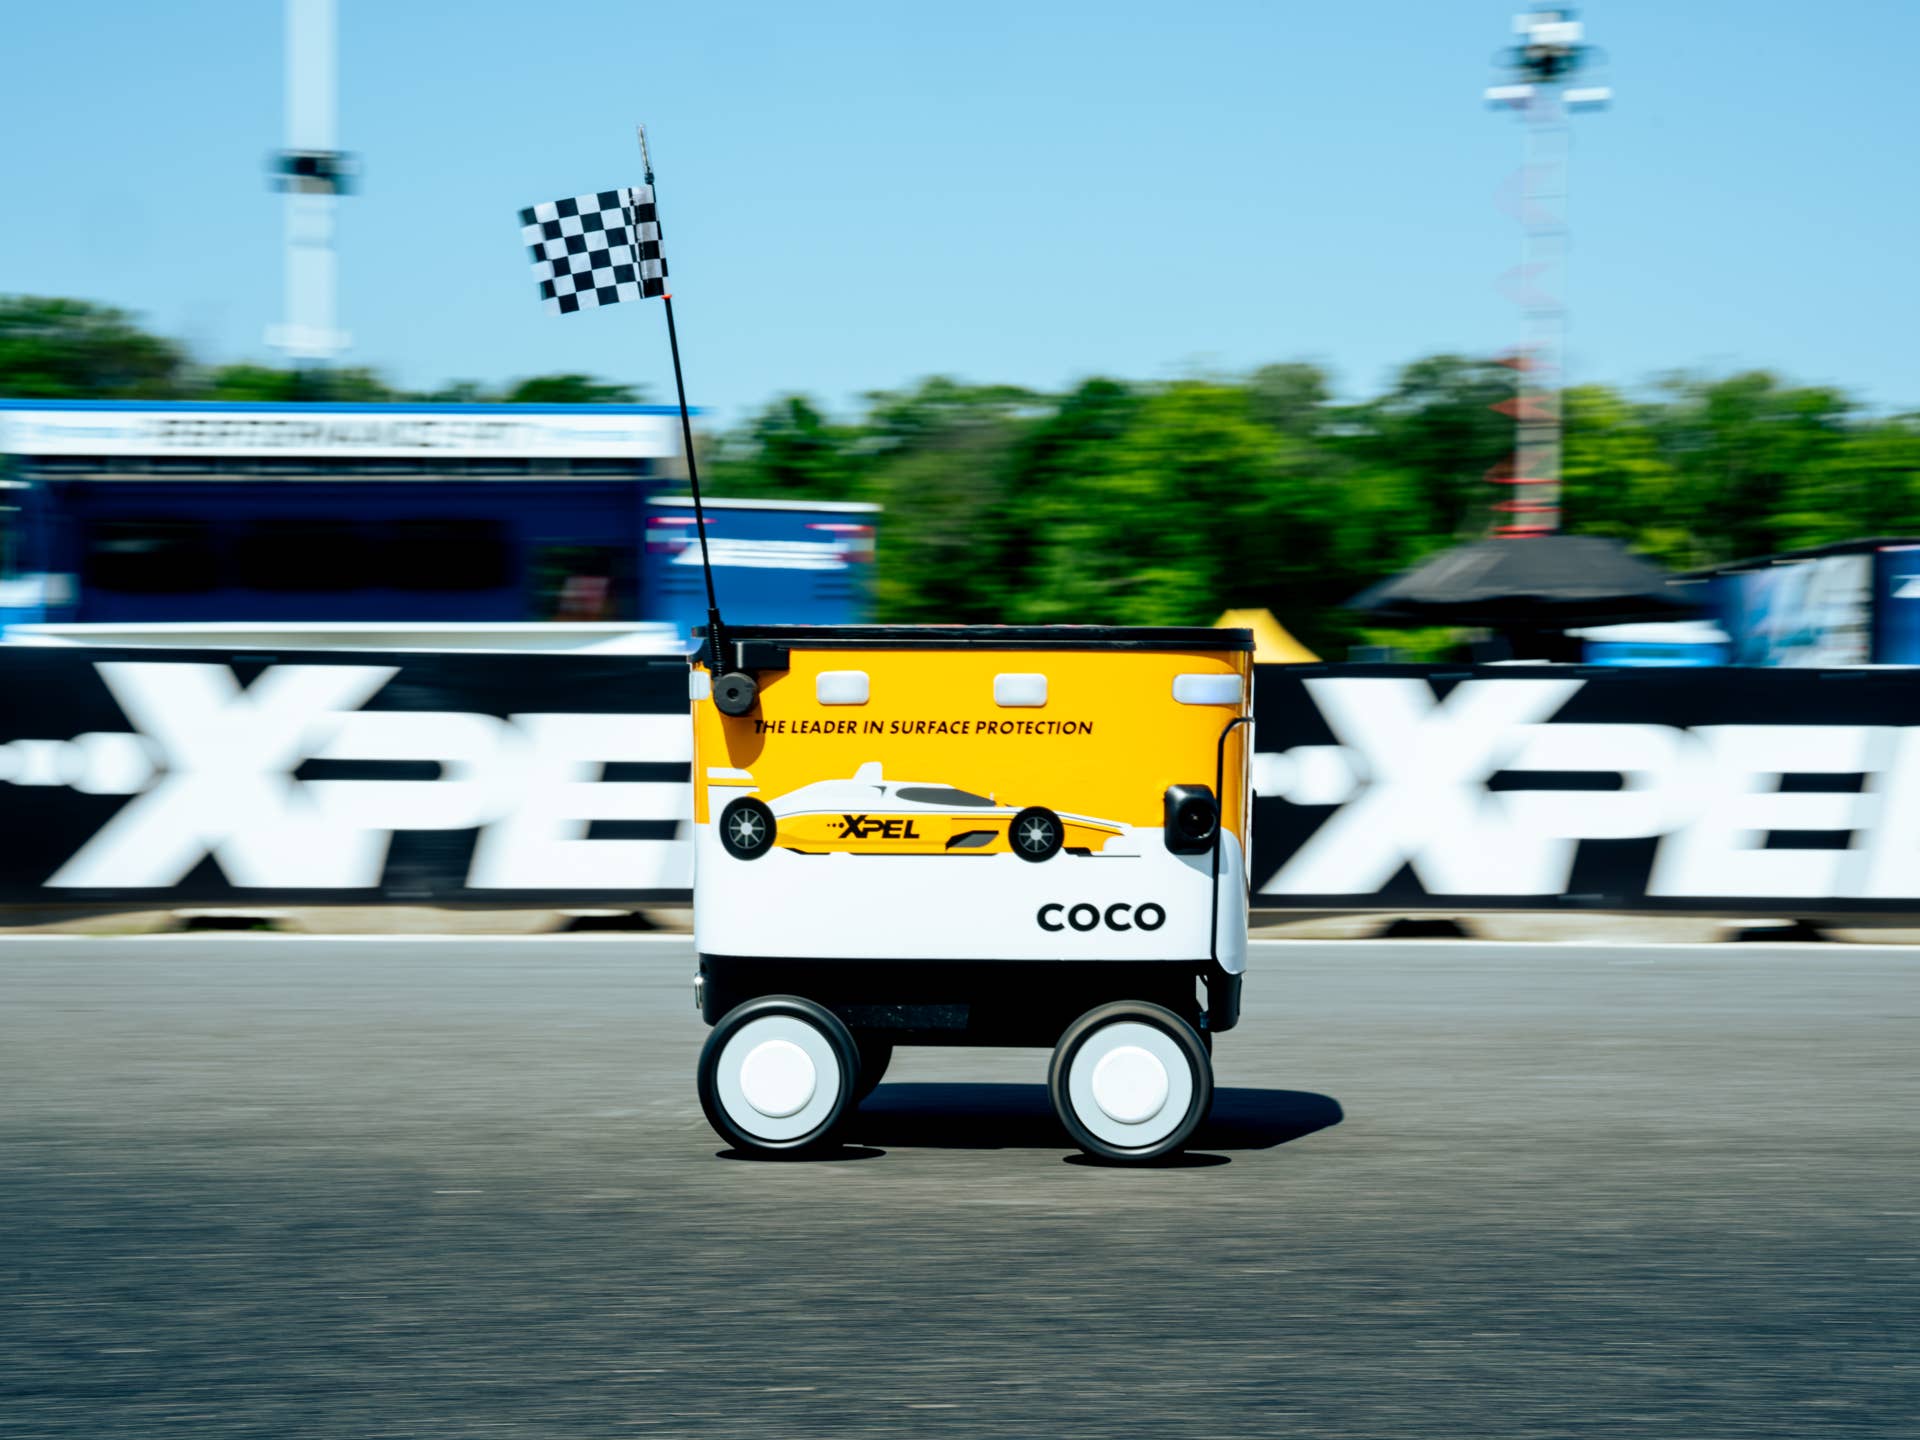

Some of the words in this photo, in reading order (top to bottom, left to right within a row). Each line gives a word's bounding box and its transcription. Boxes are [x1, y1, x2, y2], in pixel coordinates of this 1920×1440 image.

[754, 719, 786, 735] THE
[791, 719, 857, 735] LEADER
[863, 719, 885, 735] IN
[890, 719, 971, 736] SURFACE
[975, 719, 1093, 736] PROTECTION
[43, 662, 693, 889] XPE
[838, 814, 920, 839] XPEL
[1036, 902, 1167, 932] COCO
